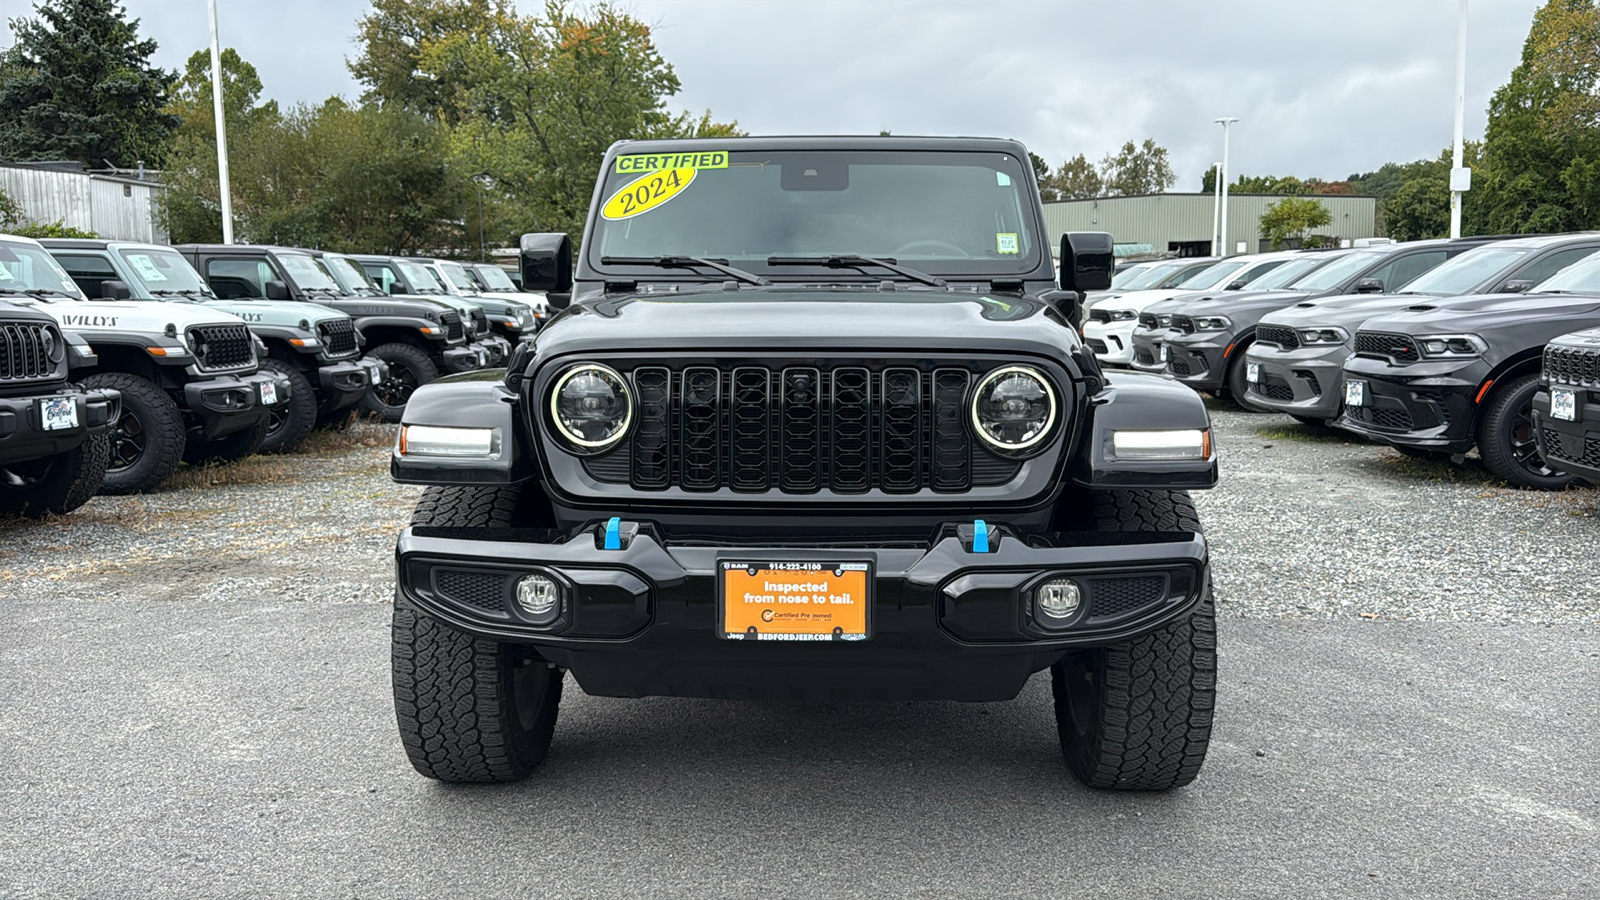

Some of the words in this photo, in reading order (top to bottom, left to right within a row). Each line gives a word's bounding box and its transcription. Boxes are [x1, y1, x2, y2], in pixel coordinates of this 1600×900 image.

[618, 153, 725, 171] CERTIFIED
[620, 169, 682, 215] 2024
[62, 314, 119, 327] WILLYS
[769, 563, 822, 571] 914-222-4100
[764, 581, 828, 594] Inspected
[743, 592, 775, 604] from
[778, 594, 809, 604] nose
[812, 594, 826, 604] to
[829, 593, 854, 605] tail.
[727, 632, 745, 640] Jeep
[757, 633, 833, 641] BEDFORDJEEP.COM
